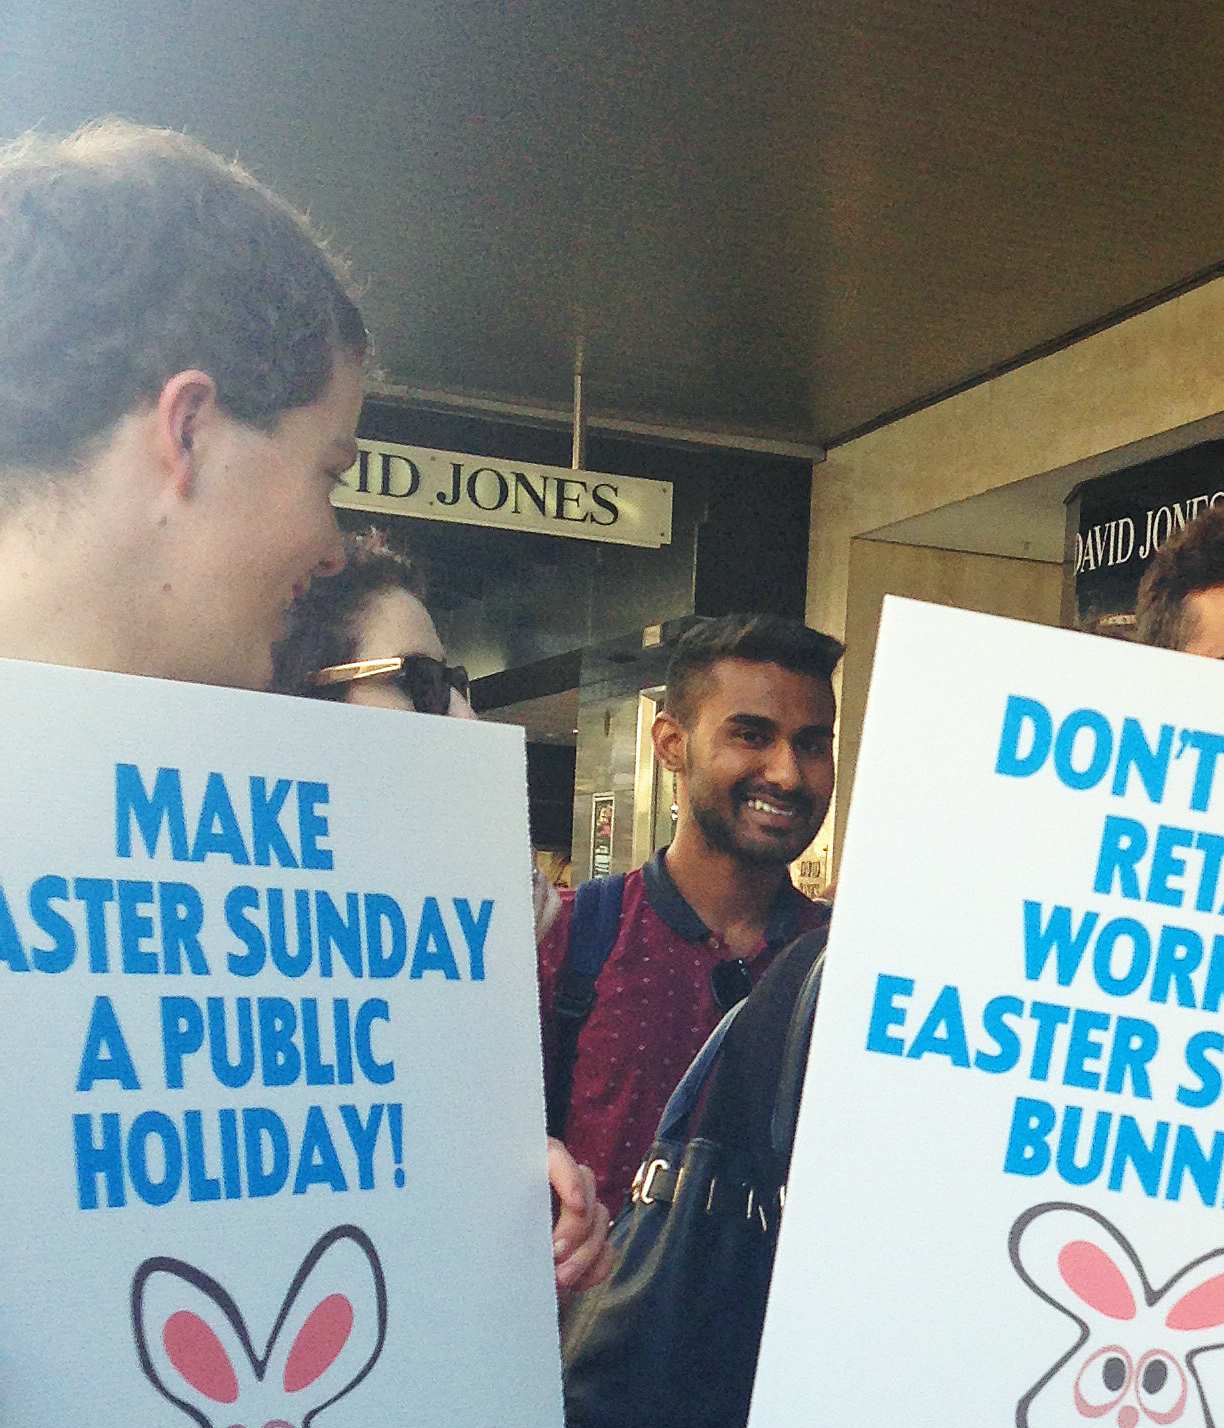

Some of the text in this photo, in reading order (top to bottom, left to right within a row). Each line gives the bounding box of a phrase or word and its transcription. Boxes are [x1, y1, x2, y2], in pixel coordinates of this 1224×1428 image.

[436, 462, 620, 527] JONES
[1073, 517, 1135, 577] DAVID
[114, 763, 335, 871] MAKE
[224, 884, 495, 981] SUNDAY
[75, 995, 396, 1092] A PUBLIC
[865, 972, 1160, 1103] EASTER
[72, 1103, 405, 1210] HOLIDAY!
